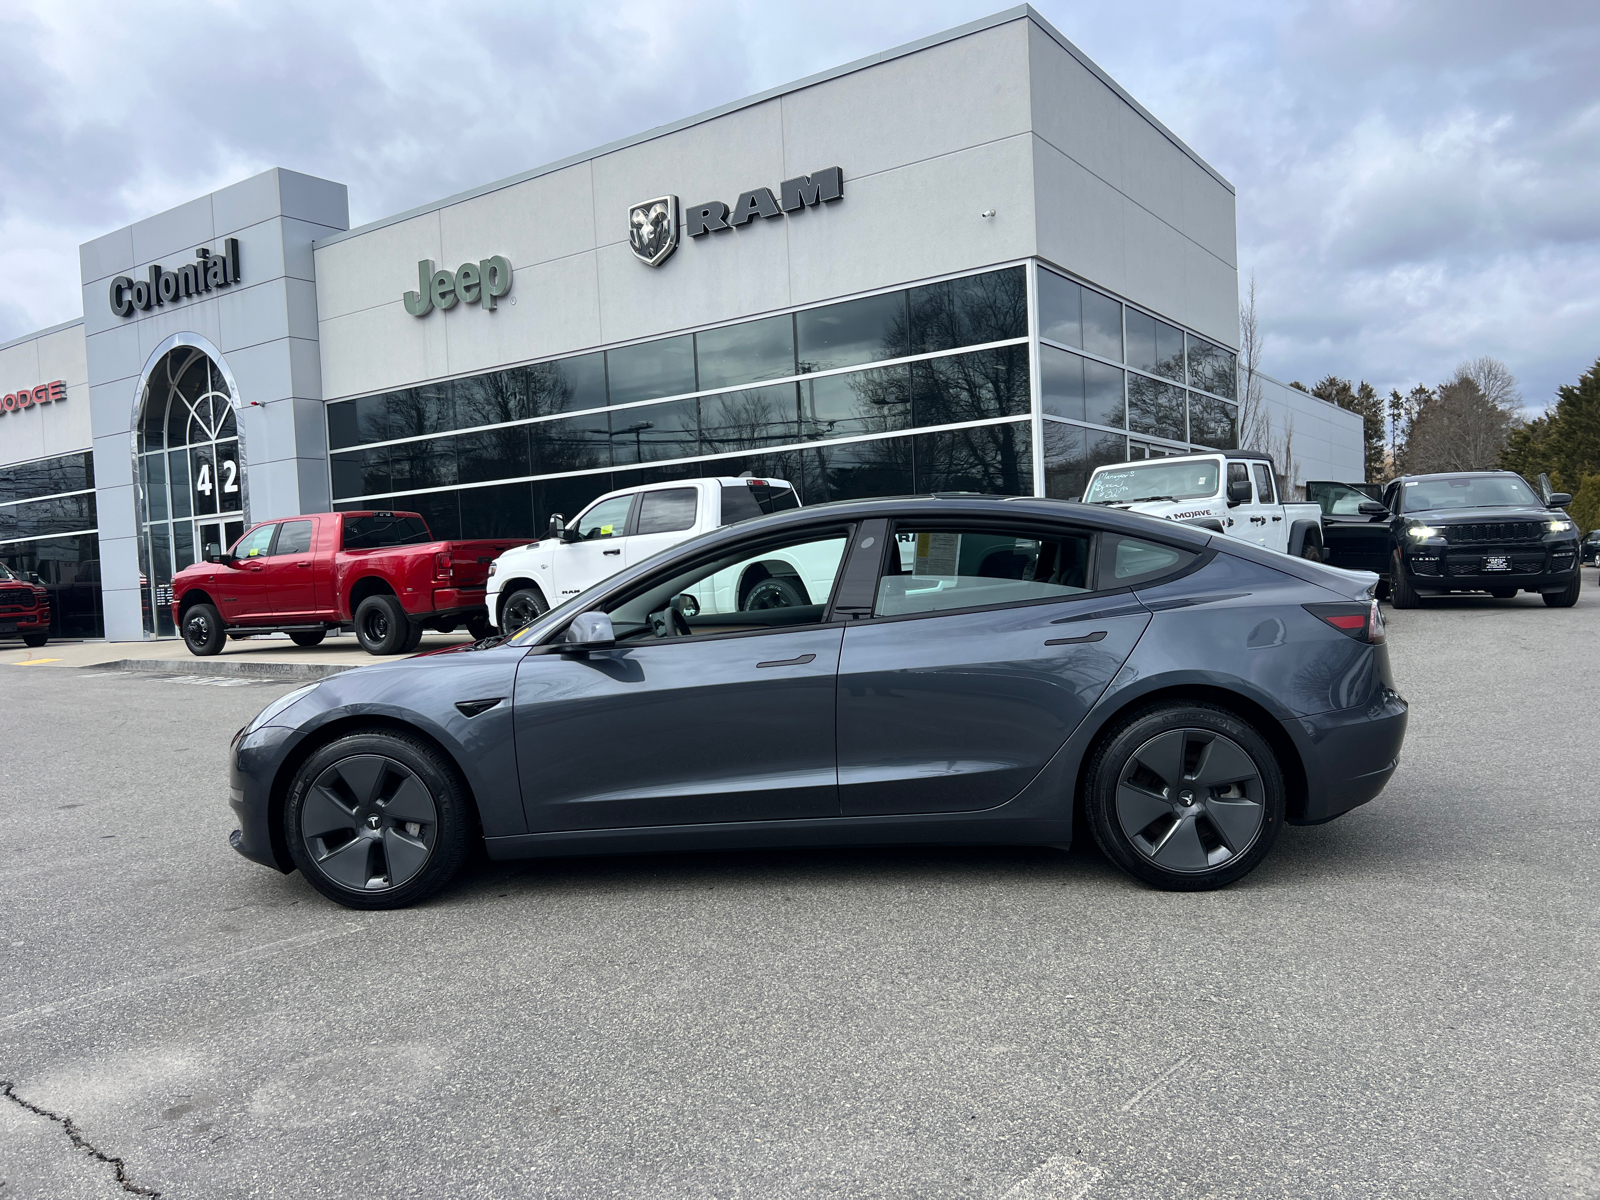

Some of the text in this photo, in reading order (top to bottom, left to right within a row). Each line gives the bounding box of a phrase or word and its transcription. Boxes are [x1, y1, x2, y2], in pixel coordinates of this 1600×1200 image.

[686, 166, 843, 238] RAM
[110, 238, 240, 317] Colonial
[403, 255, 513, 317] Jeep
[0, 380, 67, 416] ODGE
[1173, 509, 1212, 520] MOJAVE
